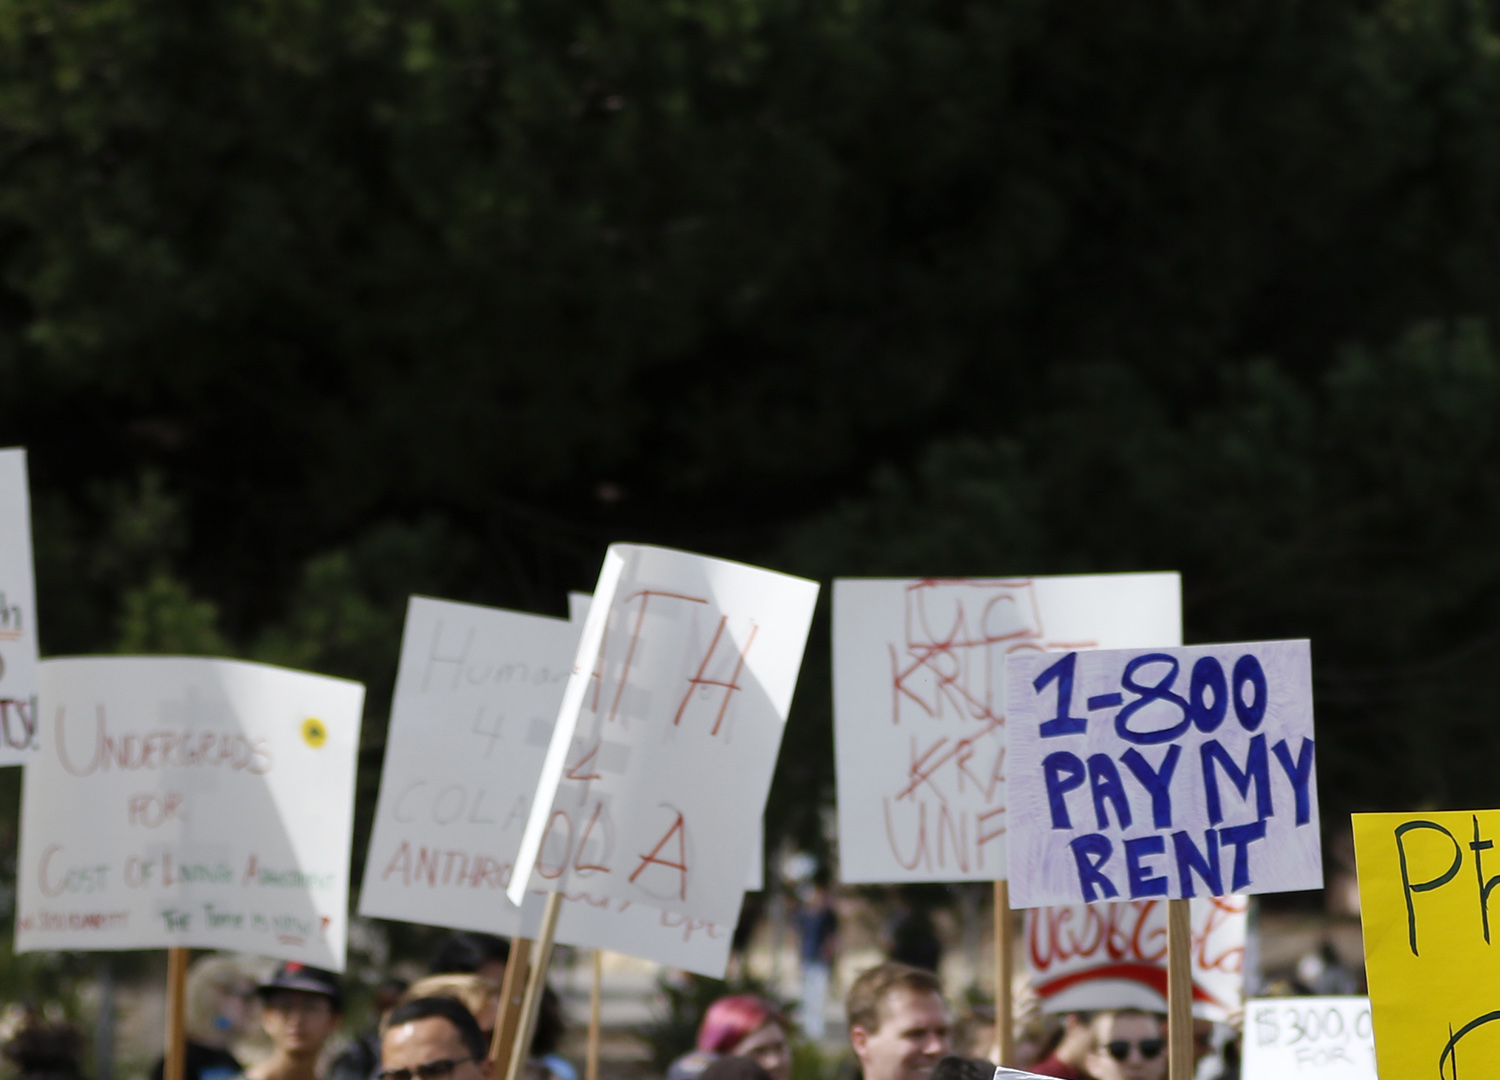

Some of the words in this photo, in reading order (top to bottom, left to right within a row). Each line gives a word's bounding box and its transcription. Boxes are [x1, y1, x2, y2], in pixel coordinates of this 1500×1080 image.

[1033, 651, 1268, 745] 1-800
[1041, 743, 1183, 830] PAY
[1200, 733, 1315, 829] MY
[1069, 818, 1268, 904] RENT
